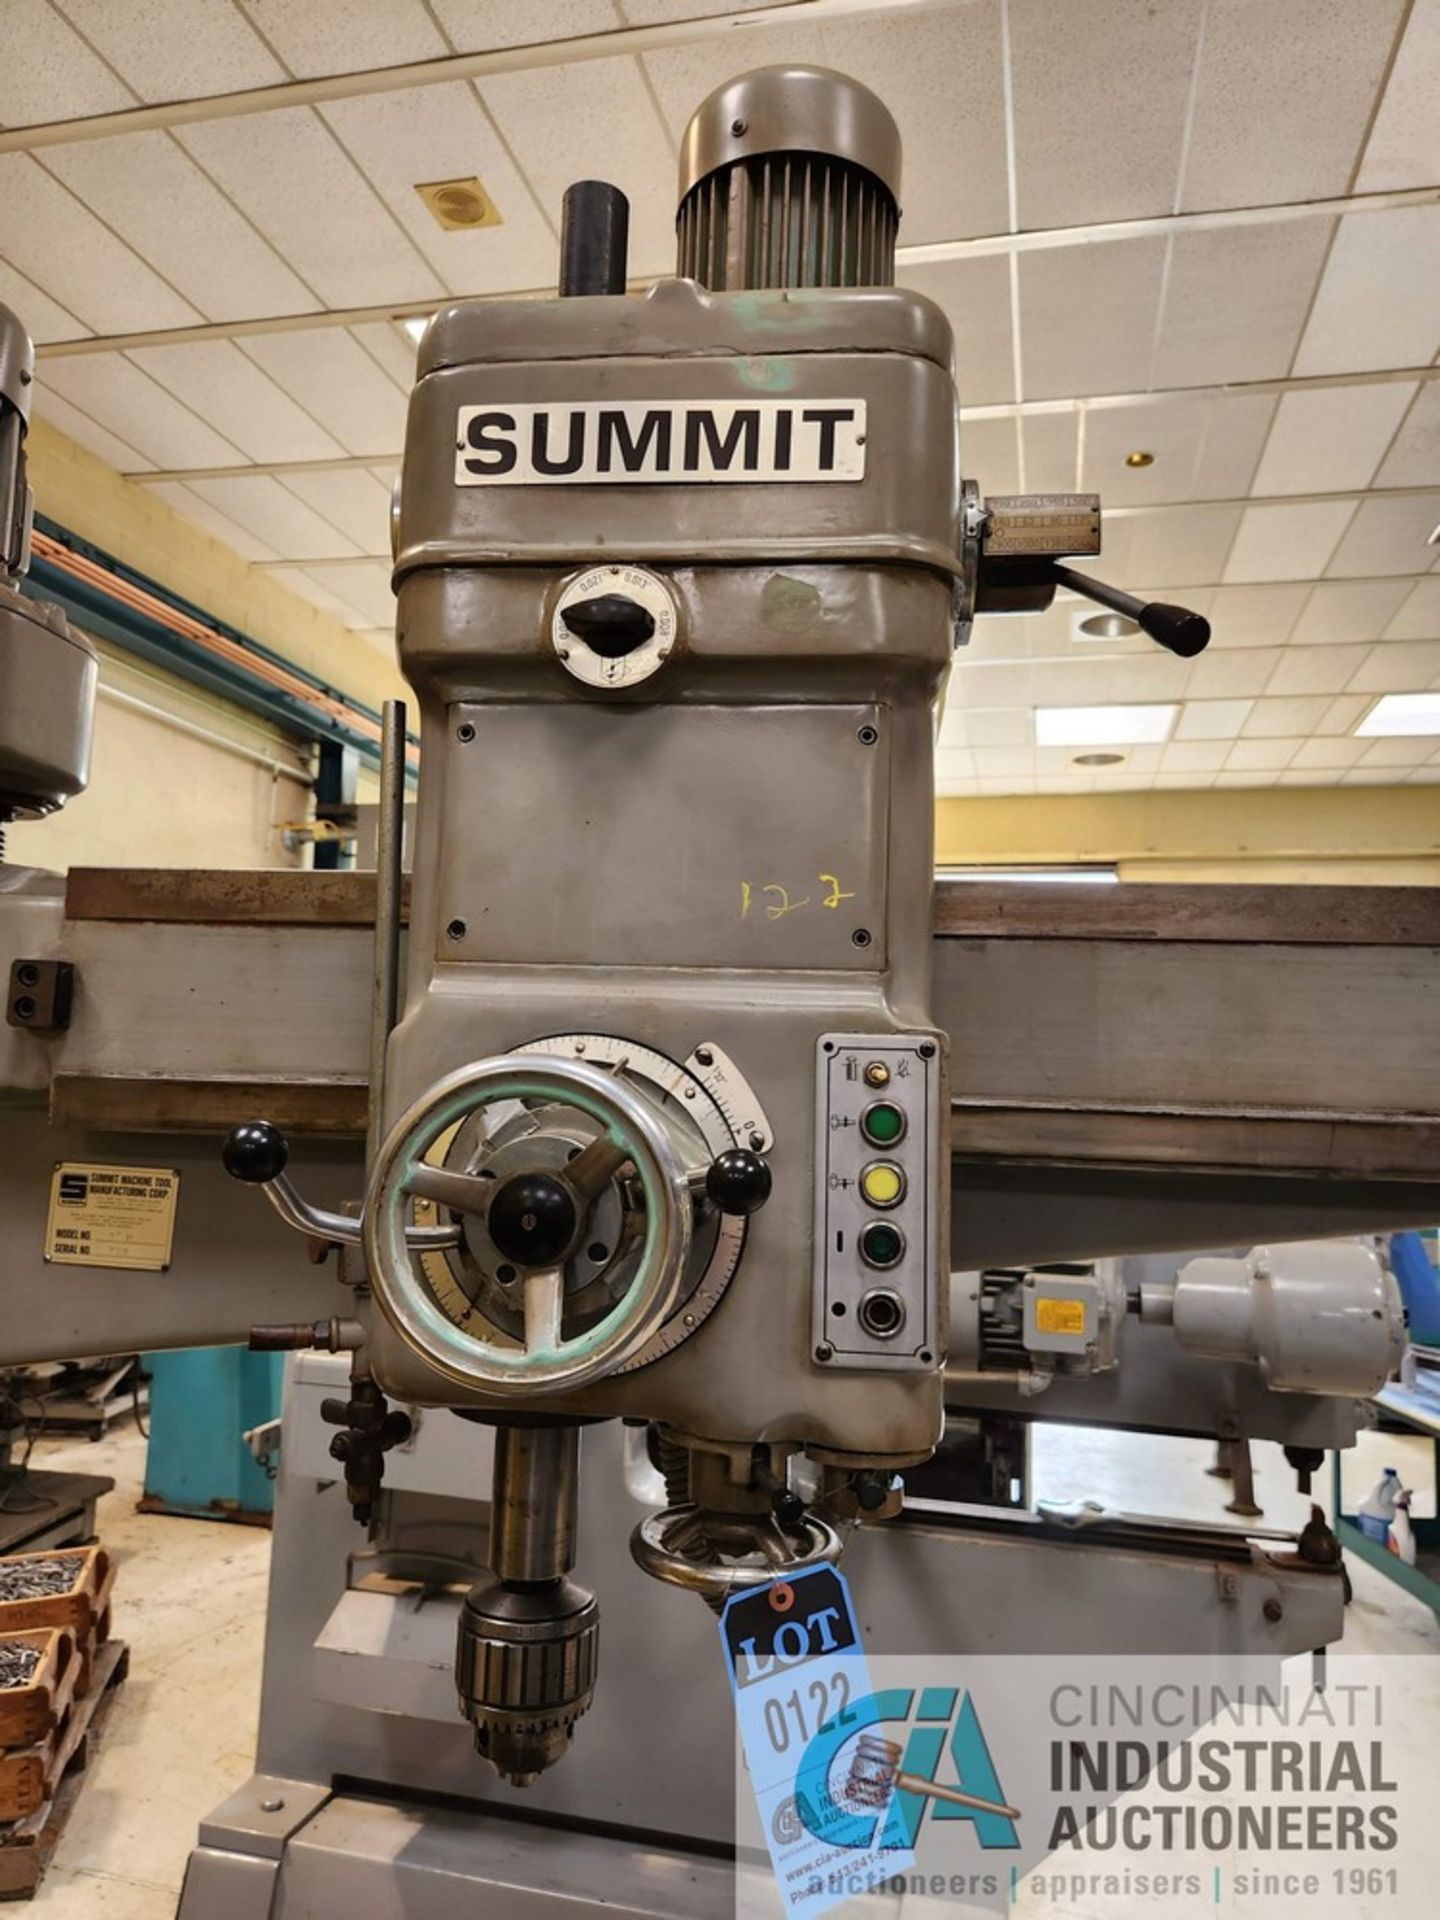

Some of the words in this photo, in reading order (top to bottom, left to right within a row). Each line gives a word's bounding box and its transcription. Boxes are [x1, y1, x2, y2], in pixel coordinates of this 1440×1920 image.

[464, 409, 855, 476] SUMMIT
[91, 1173, 119, 1183] SUMMIT
[121, 1175, 152, 1187] MACHINE
[155, 1177, 172, 1188] TOOL
[90, 1186, 148, 1198] MANUFACTURING
[56, 1228, 79, 1239] MODEL
[54, 1243, 78, 1254] SERIAL
[739, 1606, 840, 1681] LOT
[764, 1671, 857, 1754] 0122
